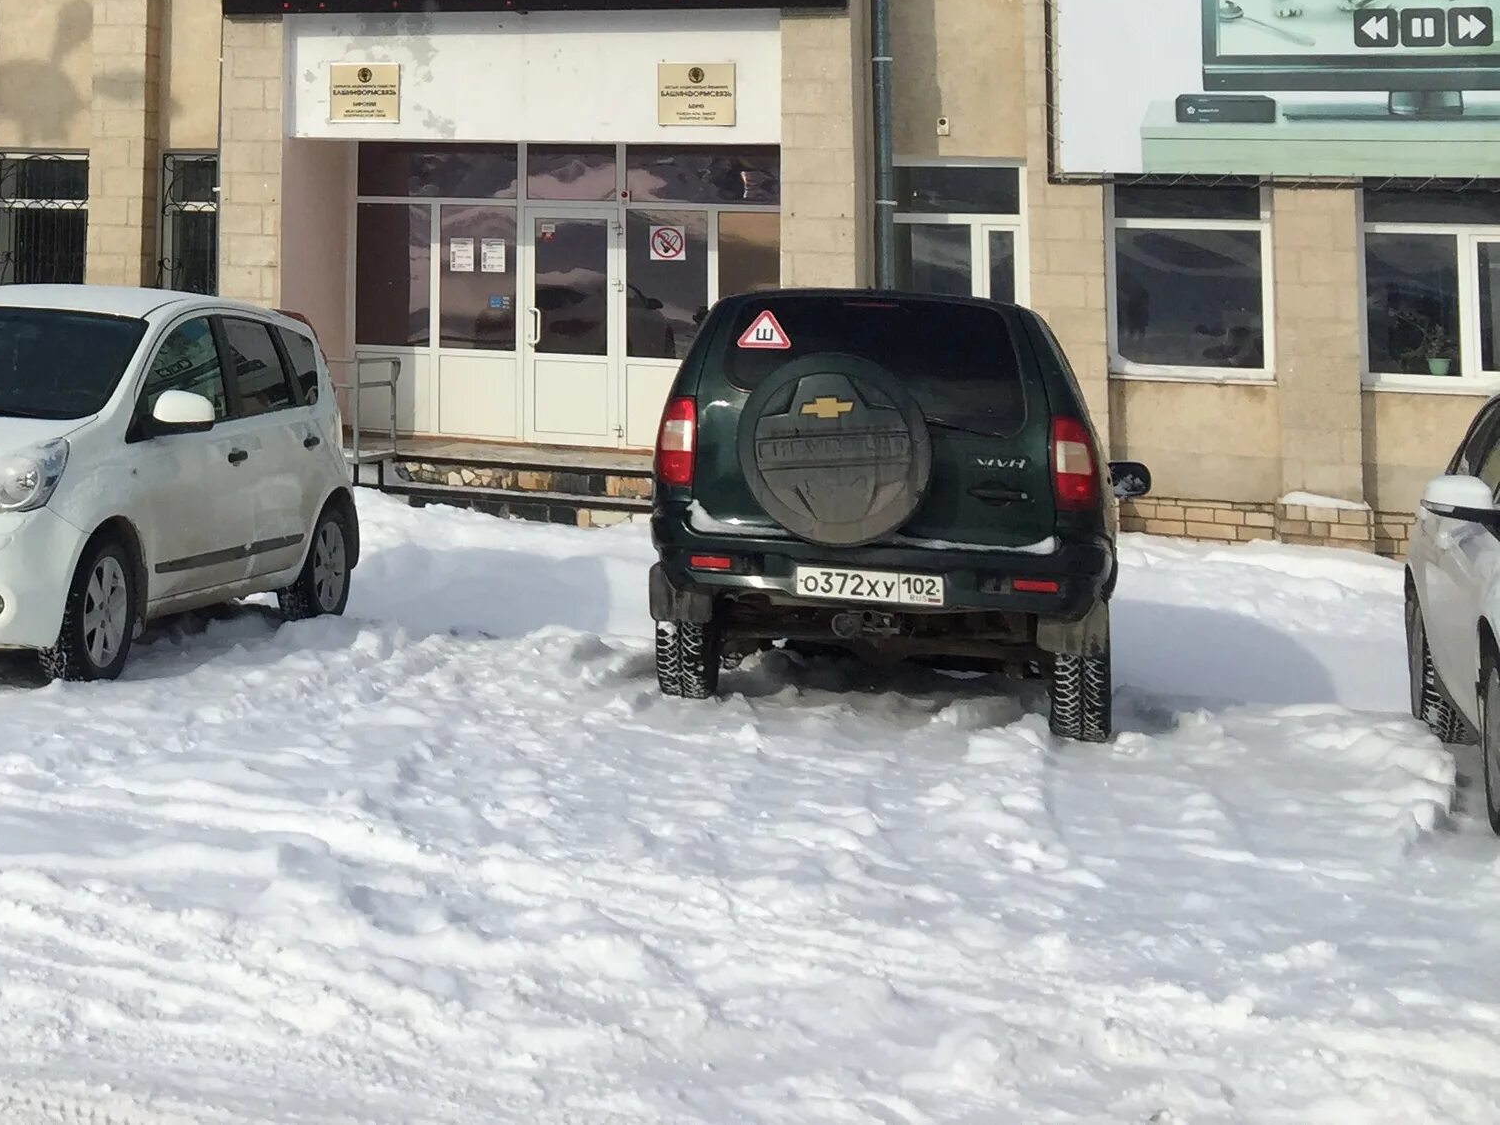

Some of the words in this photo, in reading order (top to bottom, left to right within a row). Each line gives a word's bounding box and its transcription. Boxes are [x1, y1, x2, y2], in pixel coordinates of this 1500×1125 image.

[756, 328, 773, 341] Ш
[804, 571, 895, 598] О372ХУ
[901, 577, 937, 596] 102
